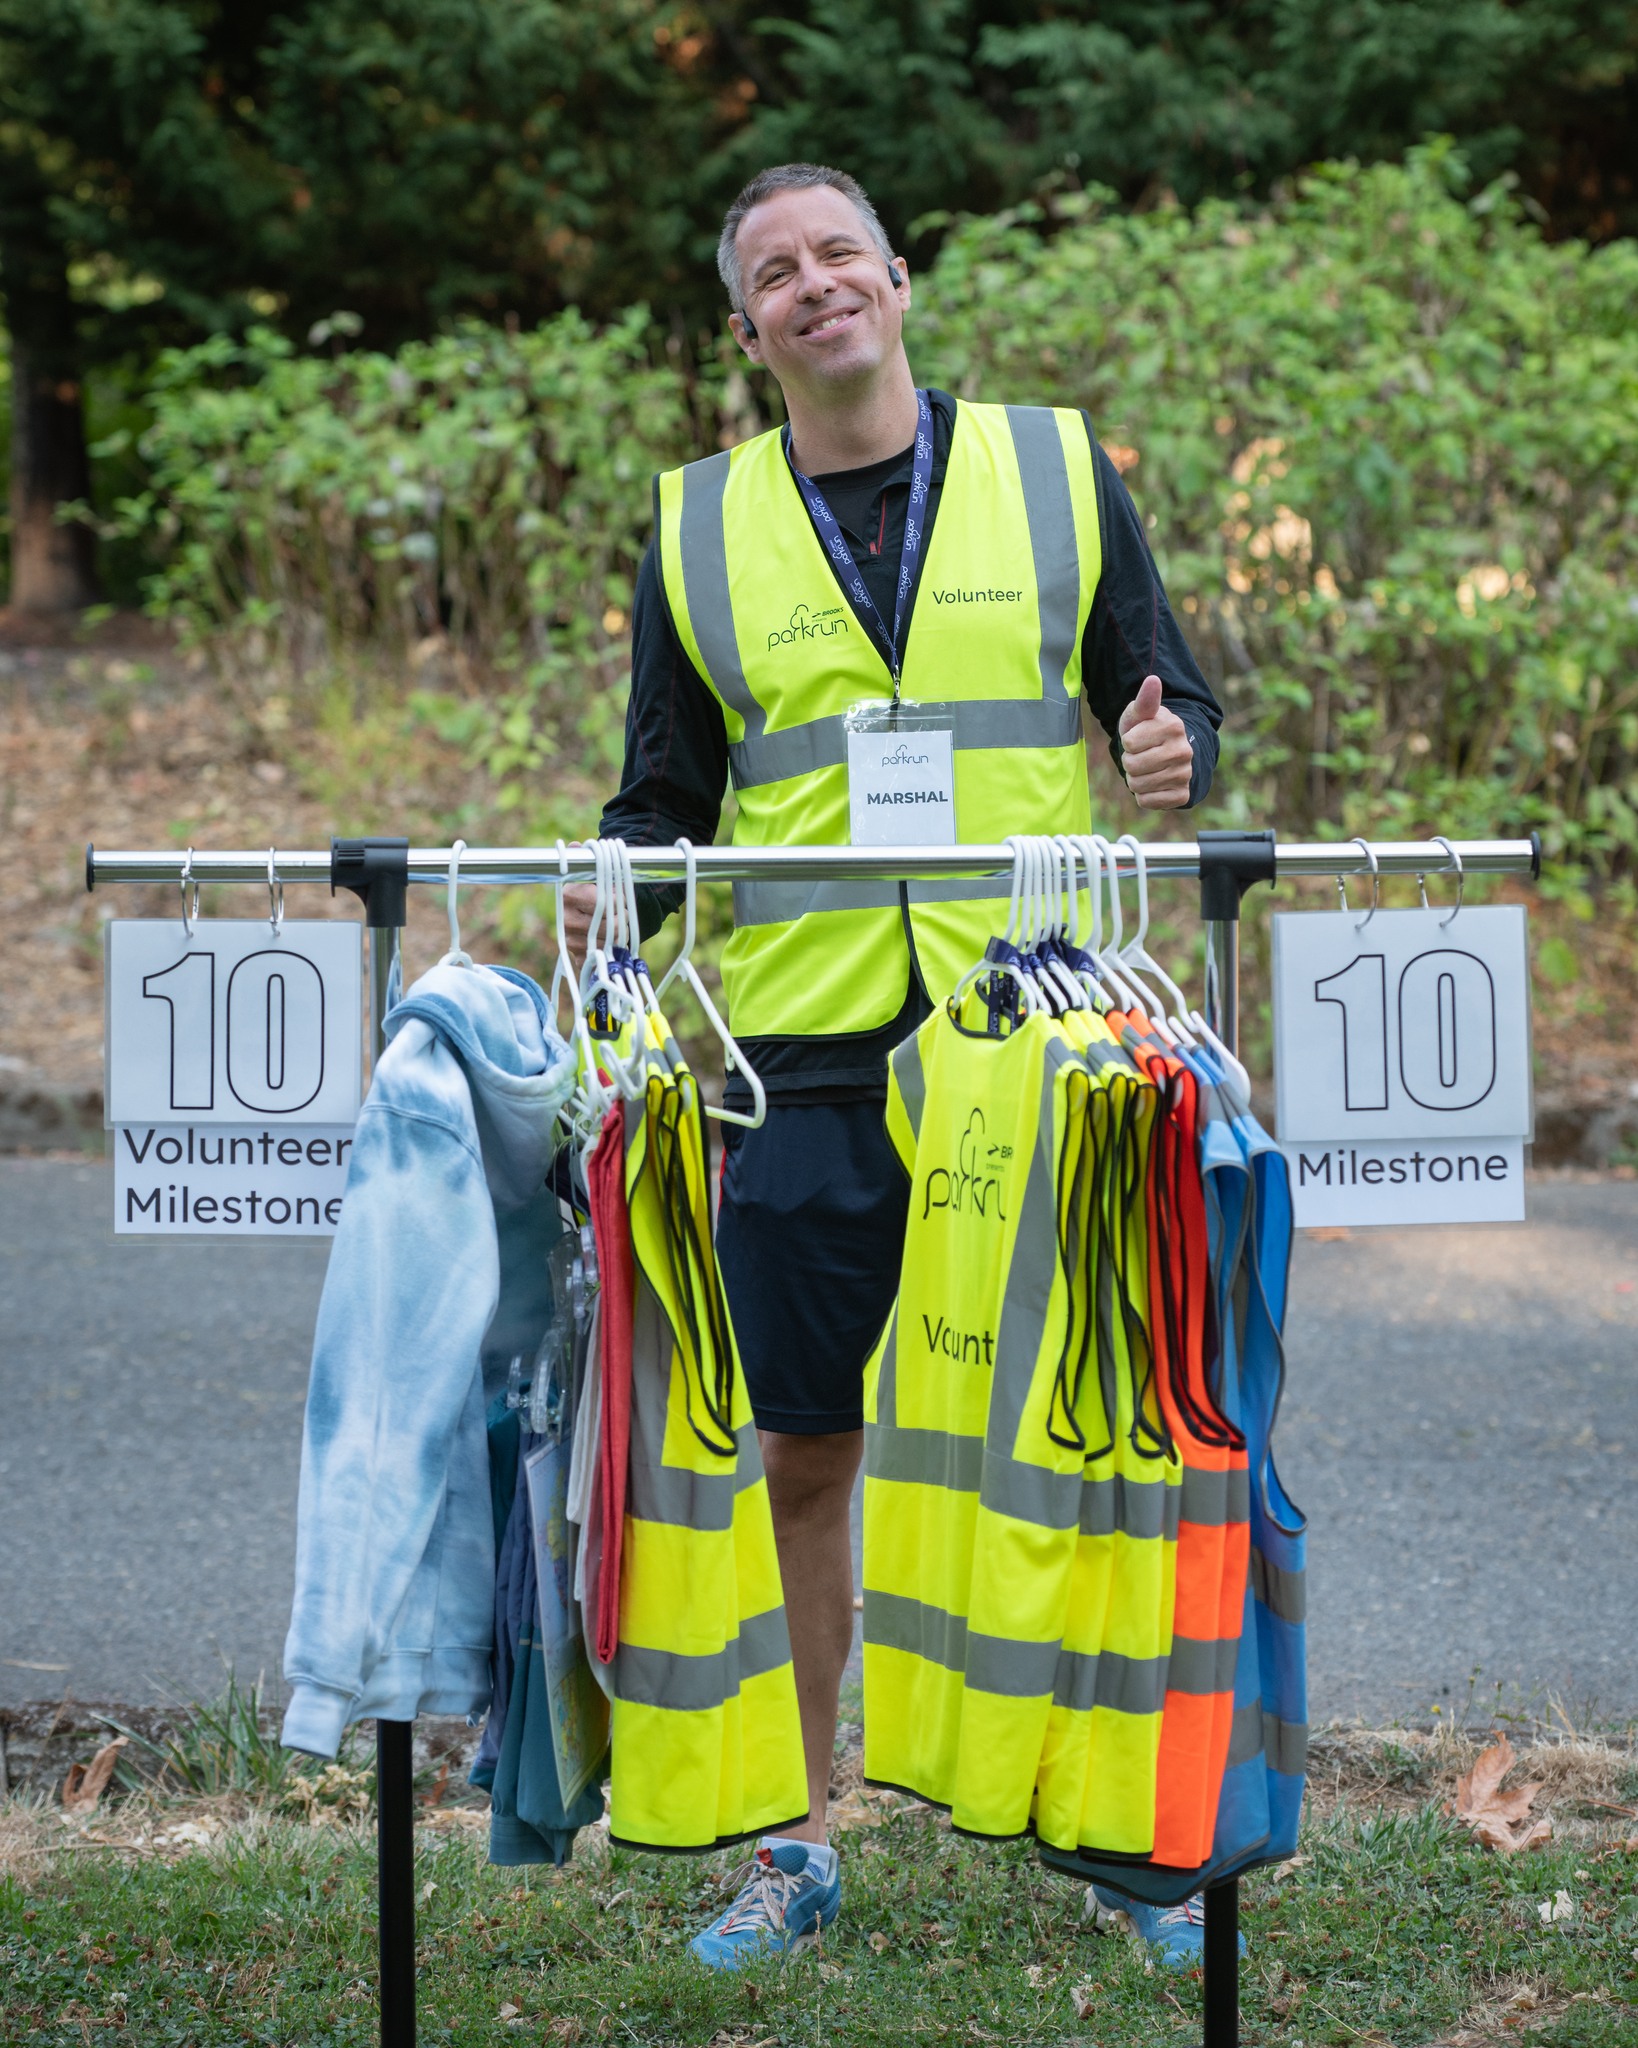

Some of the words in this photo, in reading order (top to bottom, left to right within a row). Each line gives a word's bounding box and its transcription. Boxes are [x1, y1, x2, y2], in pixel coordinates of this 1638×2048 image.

[917, 432, 930, 459] parkrun
[912, 472, 926, 504] parkrun
[813, 497, 833, 522] parkrun
[833, 535, 851, 564] parkrun
[906, 518, 919, 551] parkrun
[854, 578, 872, 608] parkrun
[899, 566, 911, 599] parkrun
[932, 588, 1023, 604] Volunteer
[822, 607, 844, 617] BROOKS
[768, 606, 848, 652] parkrun
[881, 745, 929, 767] parkrun
[867, 791, 948, 805] MARSHAL
[142, 949, 325, 1113] 10
[1315, 948, 1496, 1111] 10
[122, 1127, 353, 1167] Volunteer
[1299, 1149, 1508, 1186] Milestone
[127, 1184, 343, 1225] Milestone
